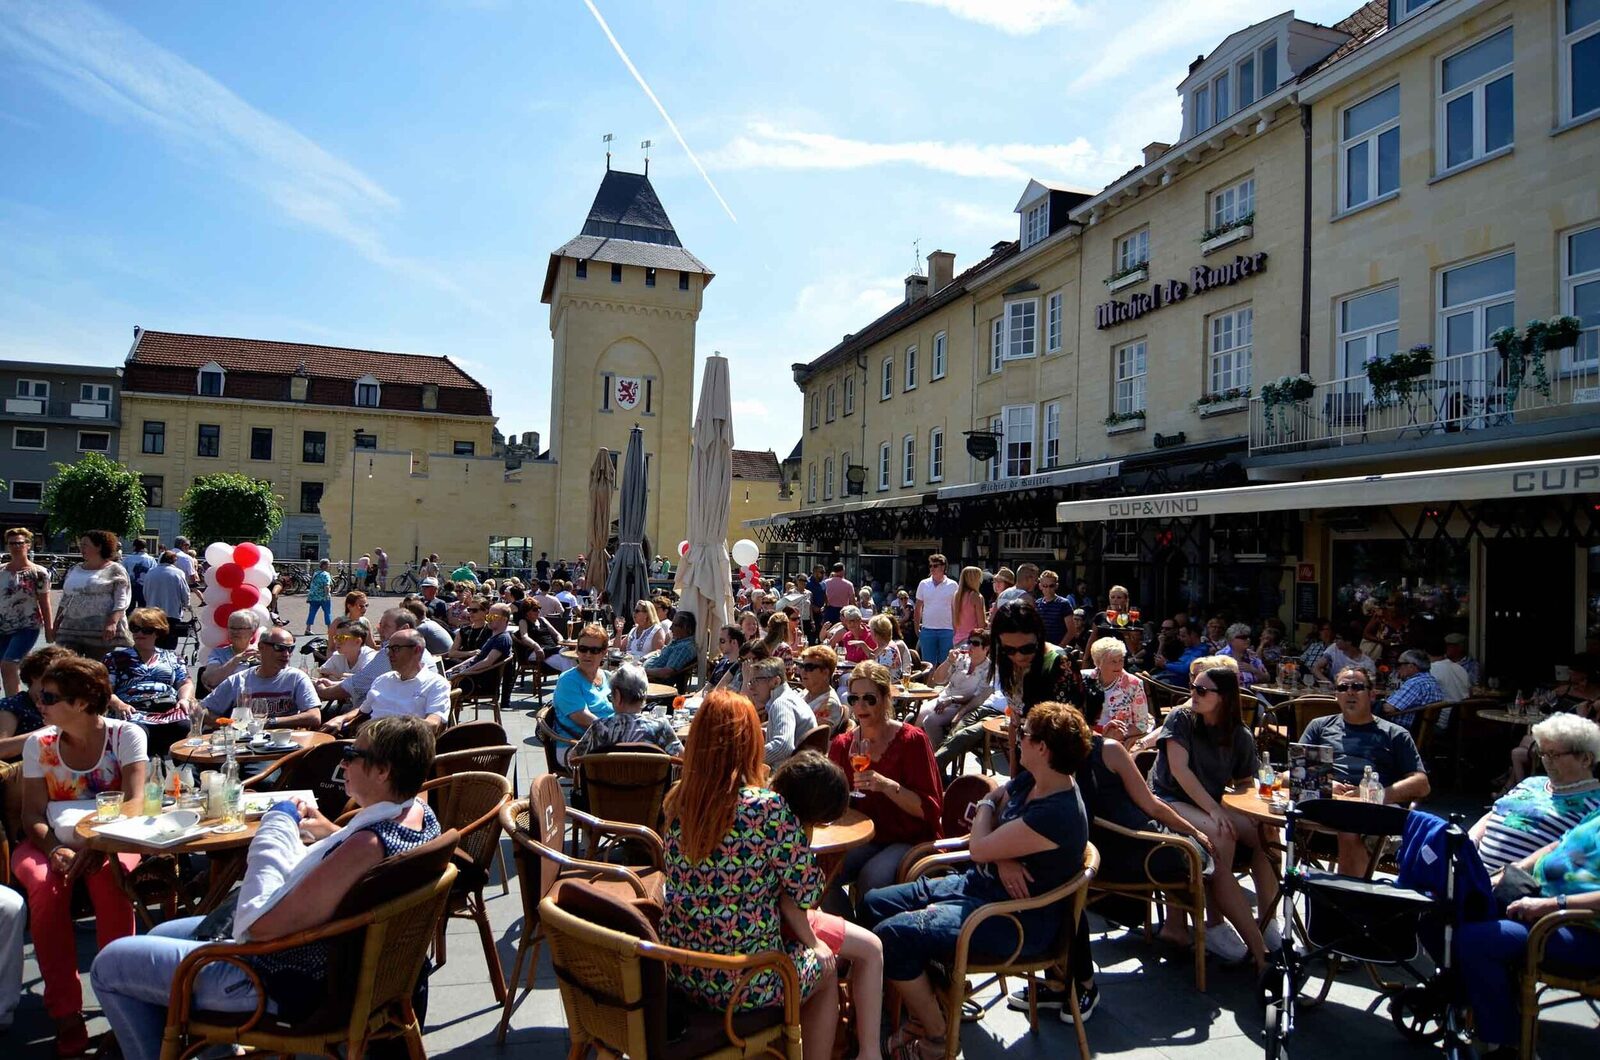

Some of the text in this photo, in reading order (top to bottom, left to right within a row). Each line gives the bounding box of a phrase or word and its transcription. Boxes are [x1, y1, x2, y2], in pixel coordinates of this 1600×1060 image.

[1095, 284, 1161, 330] Michiel
[1163, 279, 1188, 304] de
[1513, 465, 1600, 492] CUP
[1108, 498, 1199, 516] CUP&VINO
